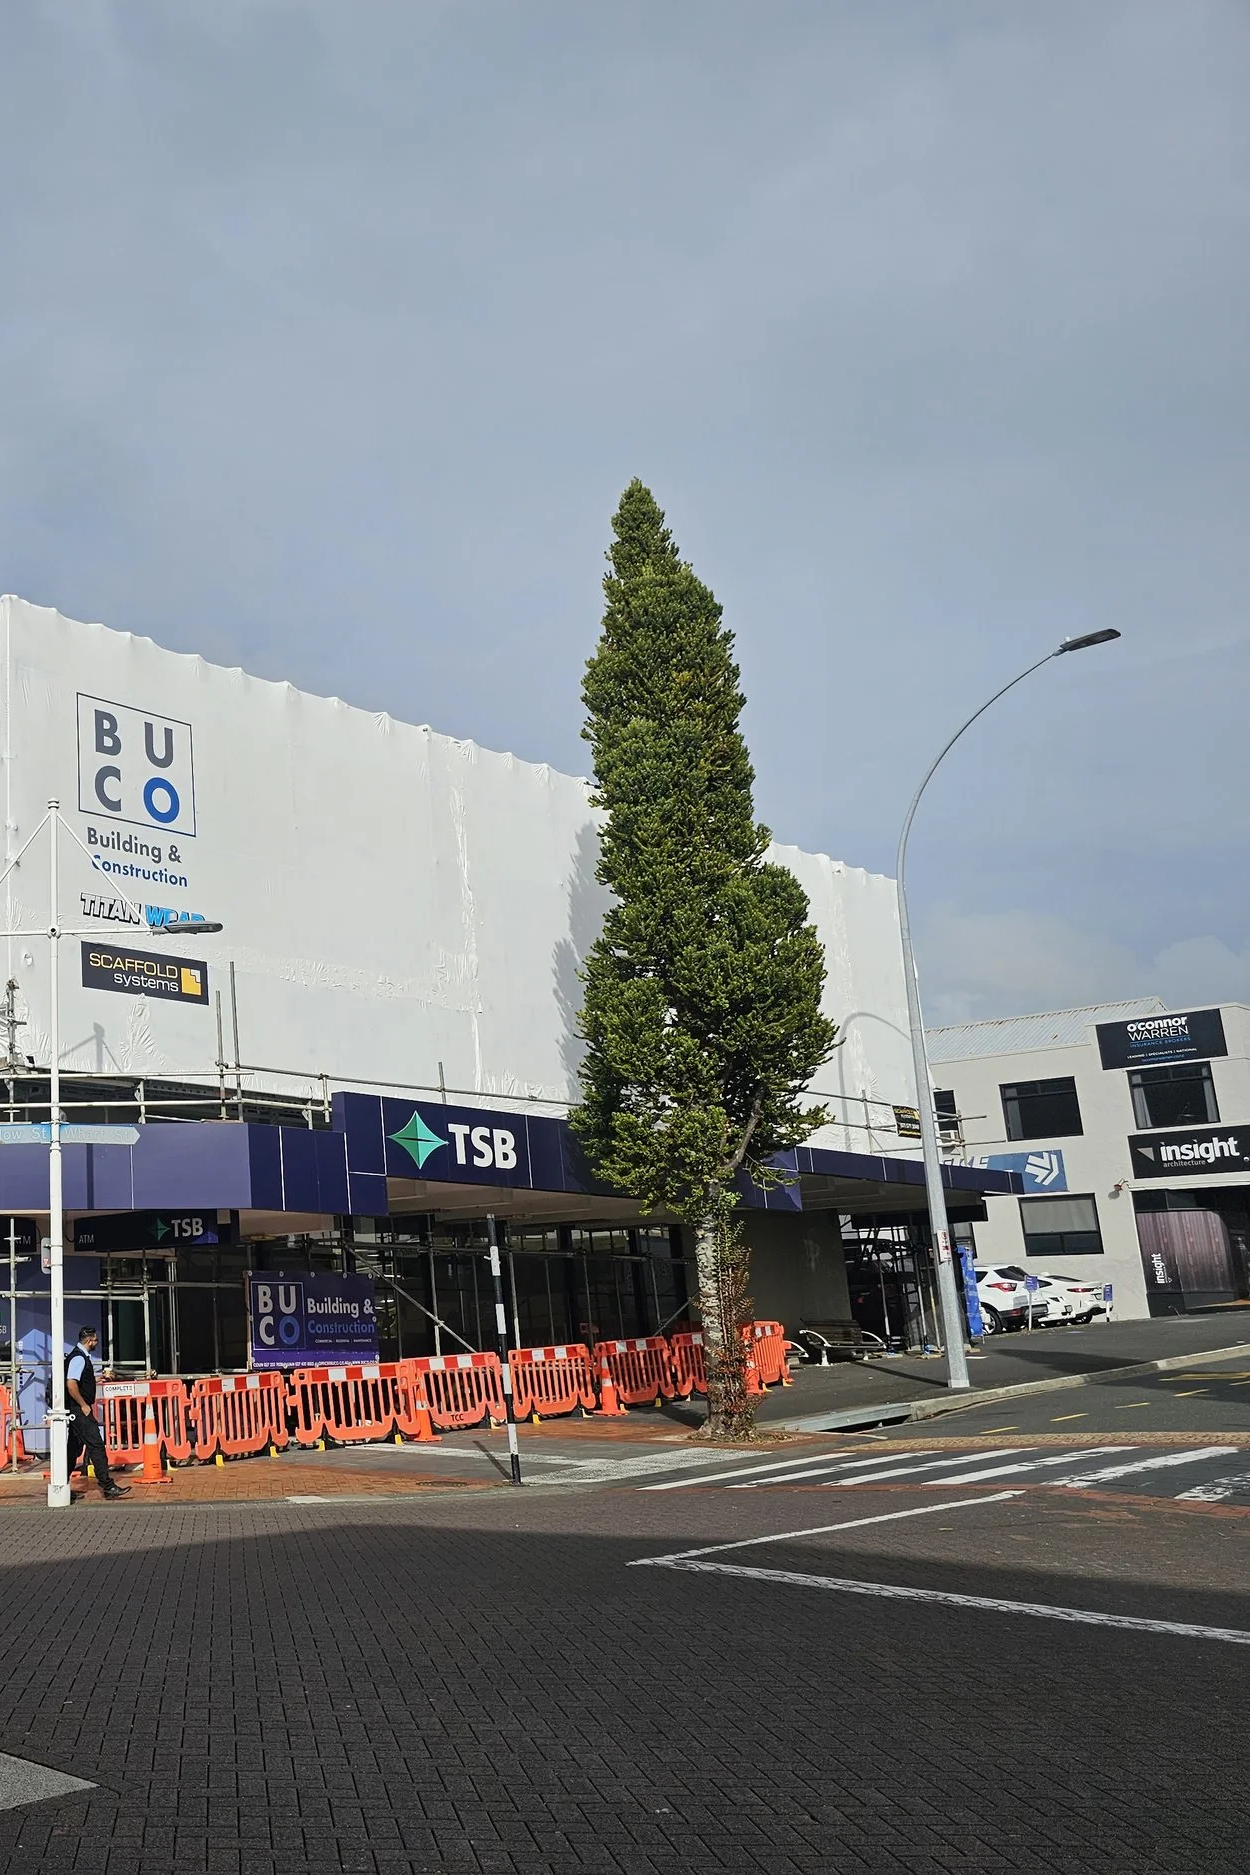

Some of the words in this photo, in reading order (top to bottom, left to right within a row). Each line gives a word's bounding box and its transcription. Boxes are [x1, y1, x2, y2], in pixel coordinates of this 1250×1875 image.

[87, 826, 162, 863] Building
[168, 844, 182, 864] &
[91, 854, 188, 888] Construction
[80, 892, 142, 925] TITAN
[89, 952, 178, 979] SCAFFOLD
[113, 973, 179, 992] systems
[1126, 1016, 1188, 1032] o'connor
[1128, 1025, 1189, 1041] WARREN
[1130, 1040, 1163, 1048] INSURANCE
[1164, 1036, 1191, 1044] BROKERS
[31, 1127, 47, 1140] St
[65, 1127, 105, 1141] Wharf
[116, 1128, 131, 1142] St
[447, 1123, 518, 1170] TSB
[1160, 1137, 1241, 1163] insight
[1163, 1159, 1206, 1168] architecture
[171, 1217, 204, 1237] TSB
[79, 1234, 94, 1244] ATM
[1150, 1253, 1166, 1284] insight
[307, 1297, 359, 1319] Building
[363, 1298, 375, 1314] &
[307, 1320, 375, 1334] Construction
[450, 1414, 464, 1422] TCC
